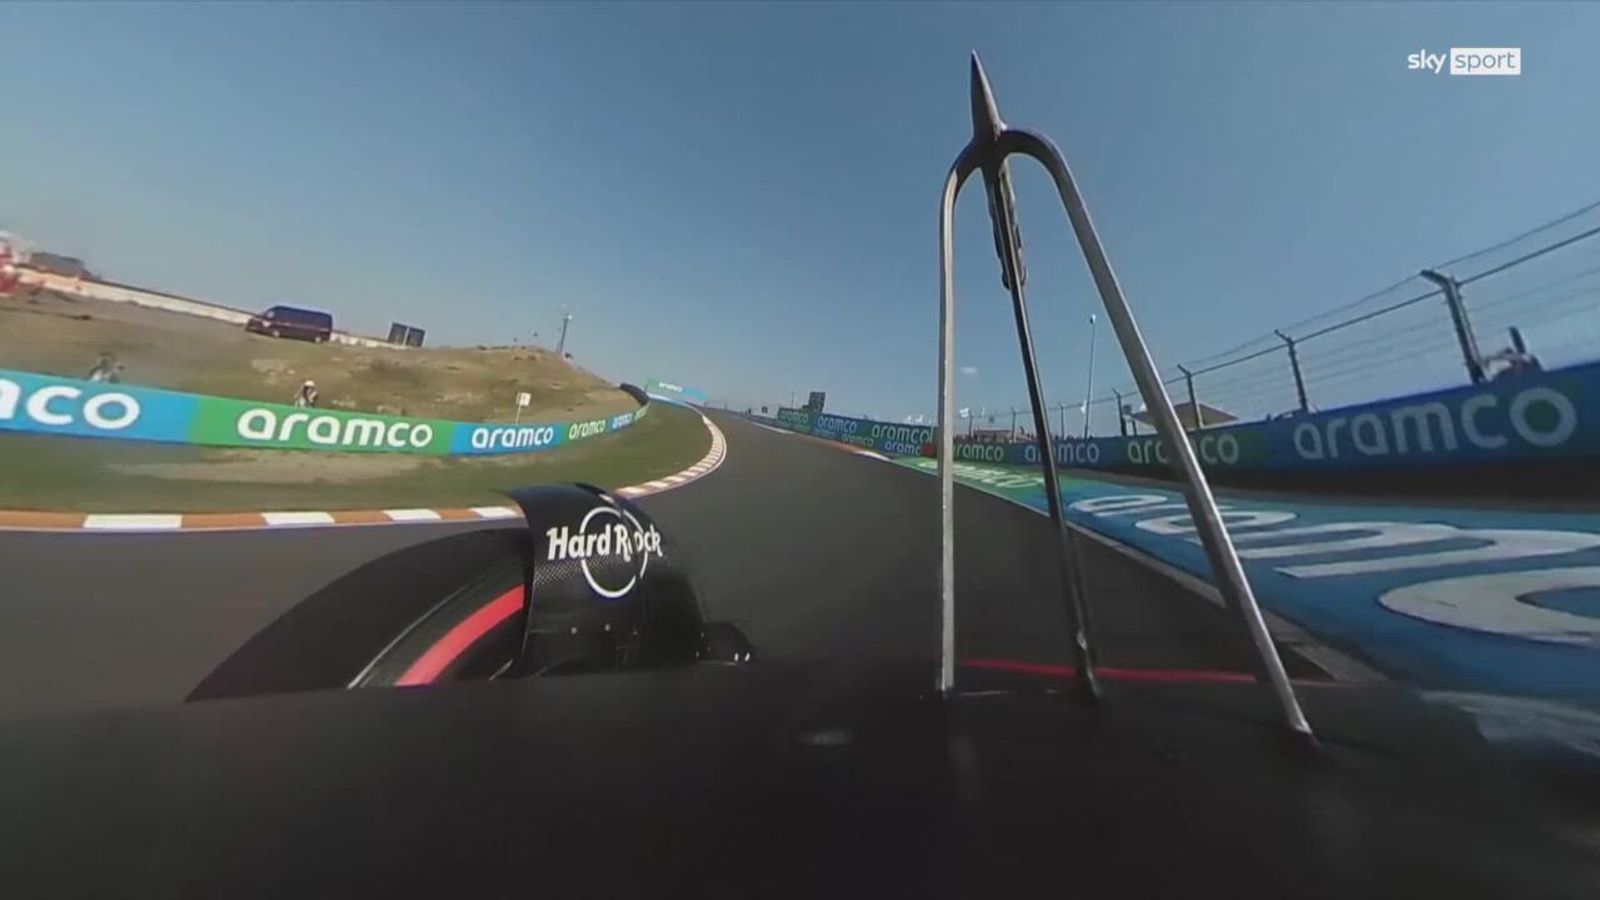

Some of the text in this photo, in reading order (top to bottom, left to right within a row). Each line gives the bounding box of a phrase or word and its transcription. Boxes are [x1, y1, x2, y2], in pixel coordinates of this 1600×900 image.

[237, 408, 433, 448] aramco
[568, 419, 606, 439] aramco
[817, 414, 857, 433] aramco
[1293, 387, 1577, 459] aramco
[471, 427, 554, 448] aramco
[872, 424, 931, 443] aramco
[884, 440, 922, 456] aramc
[953, 443, 1004, 461] ramco
[546, 523, 663, 562] Hard Rock
